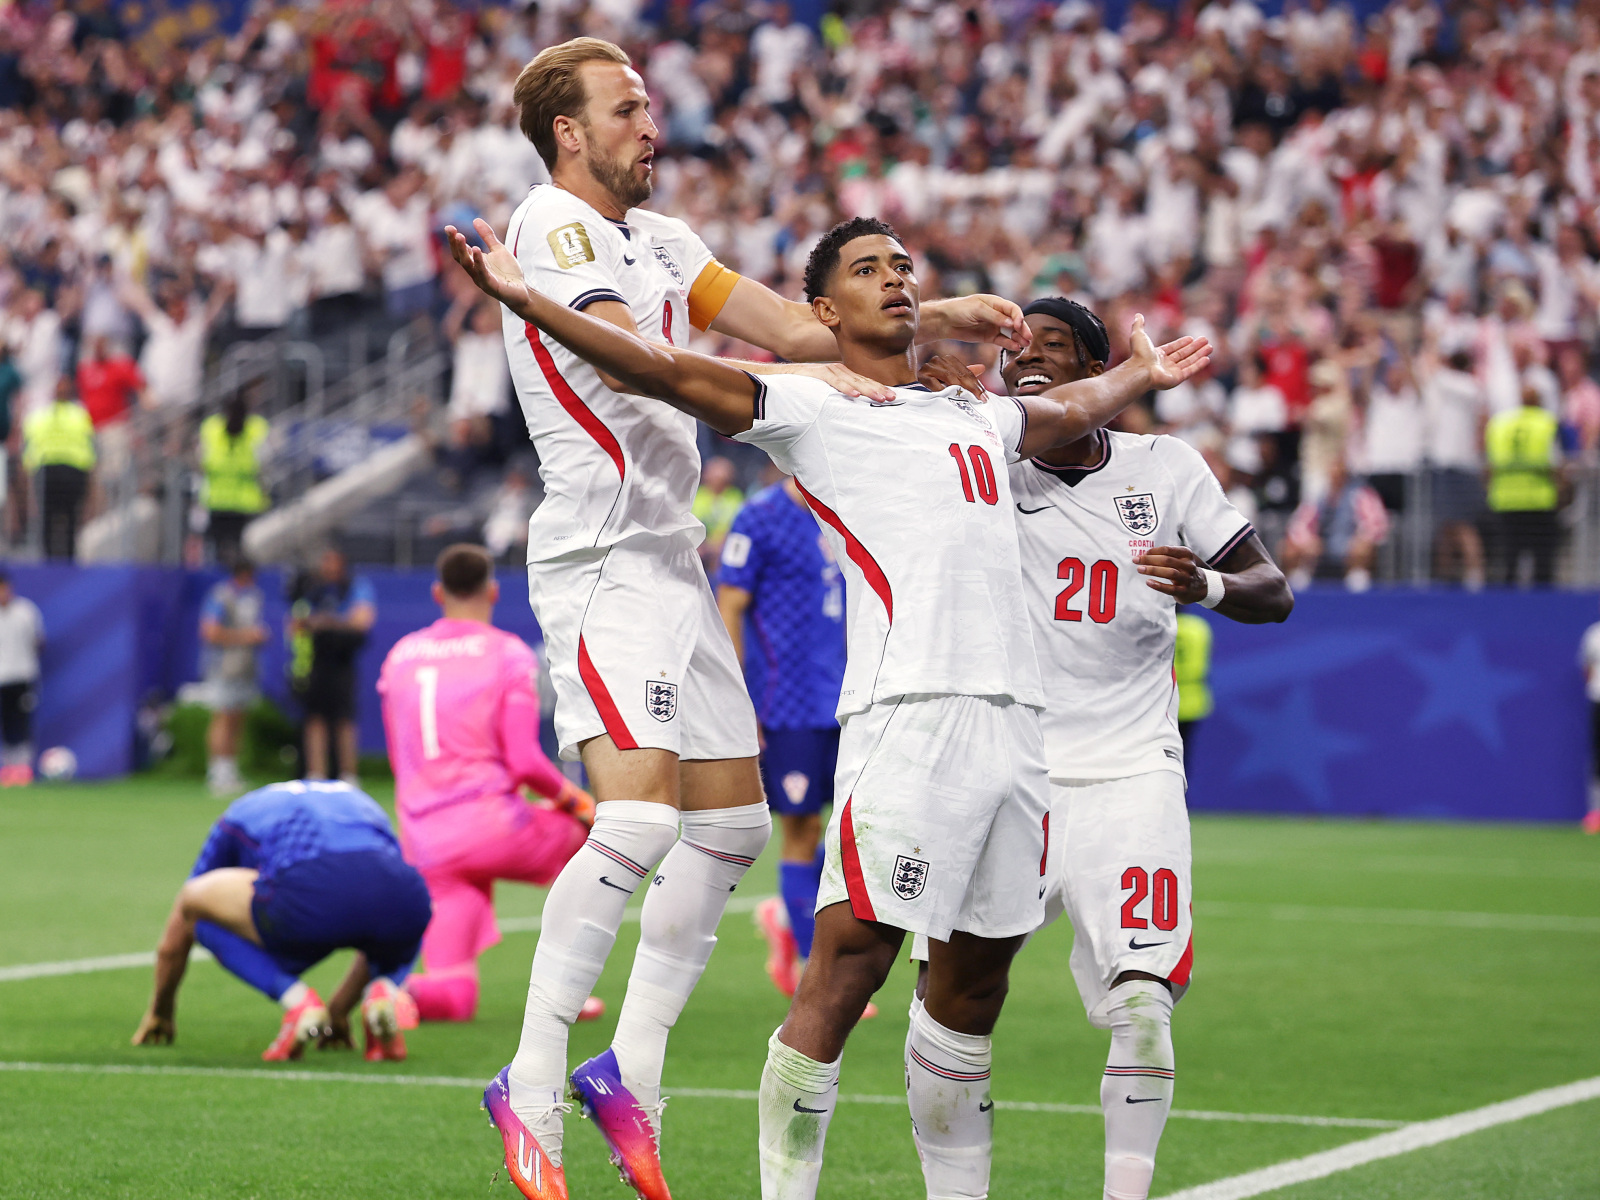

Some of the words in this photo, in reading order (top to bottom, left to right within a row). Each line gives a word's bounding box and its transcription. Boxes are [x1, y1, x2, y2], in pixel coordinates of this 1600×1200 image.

[662, 299, 675, 347] 9
[948, 442, 999, 506] 10
[1054, 556, 1119, 624] 20
[415, 666, 441, 761] 1
[1120, 866, 1178, 931] 20
